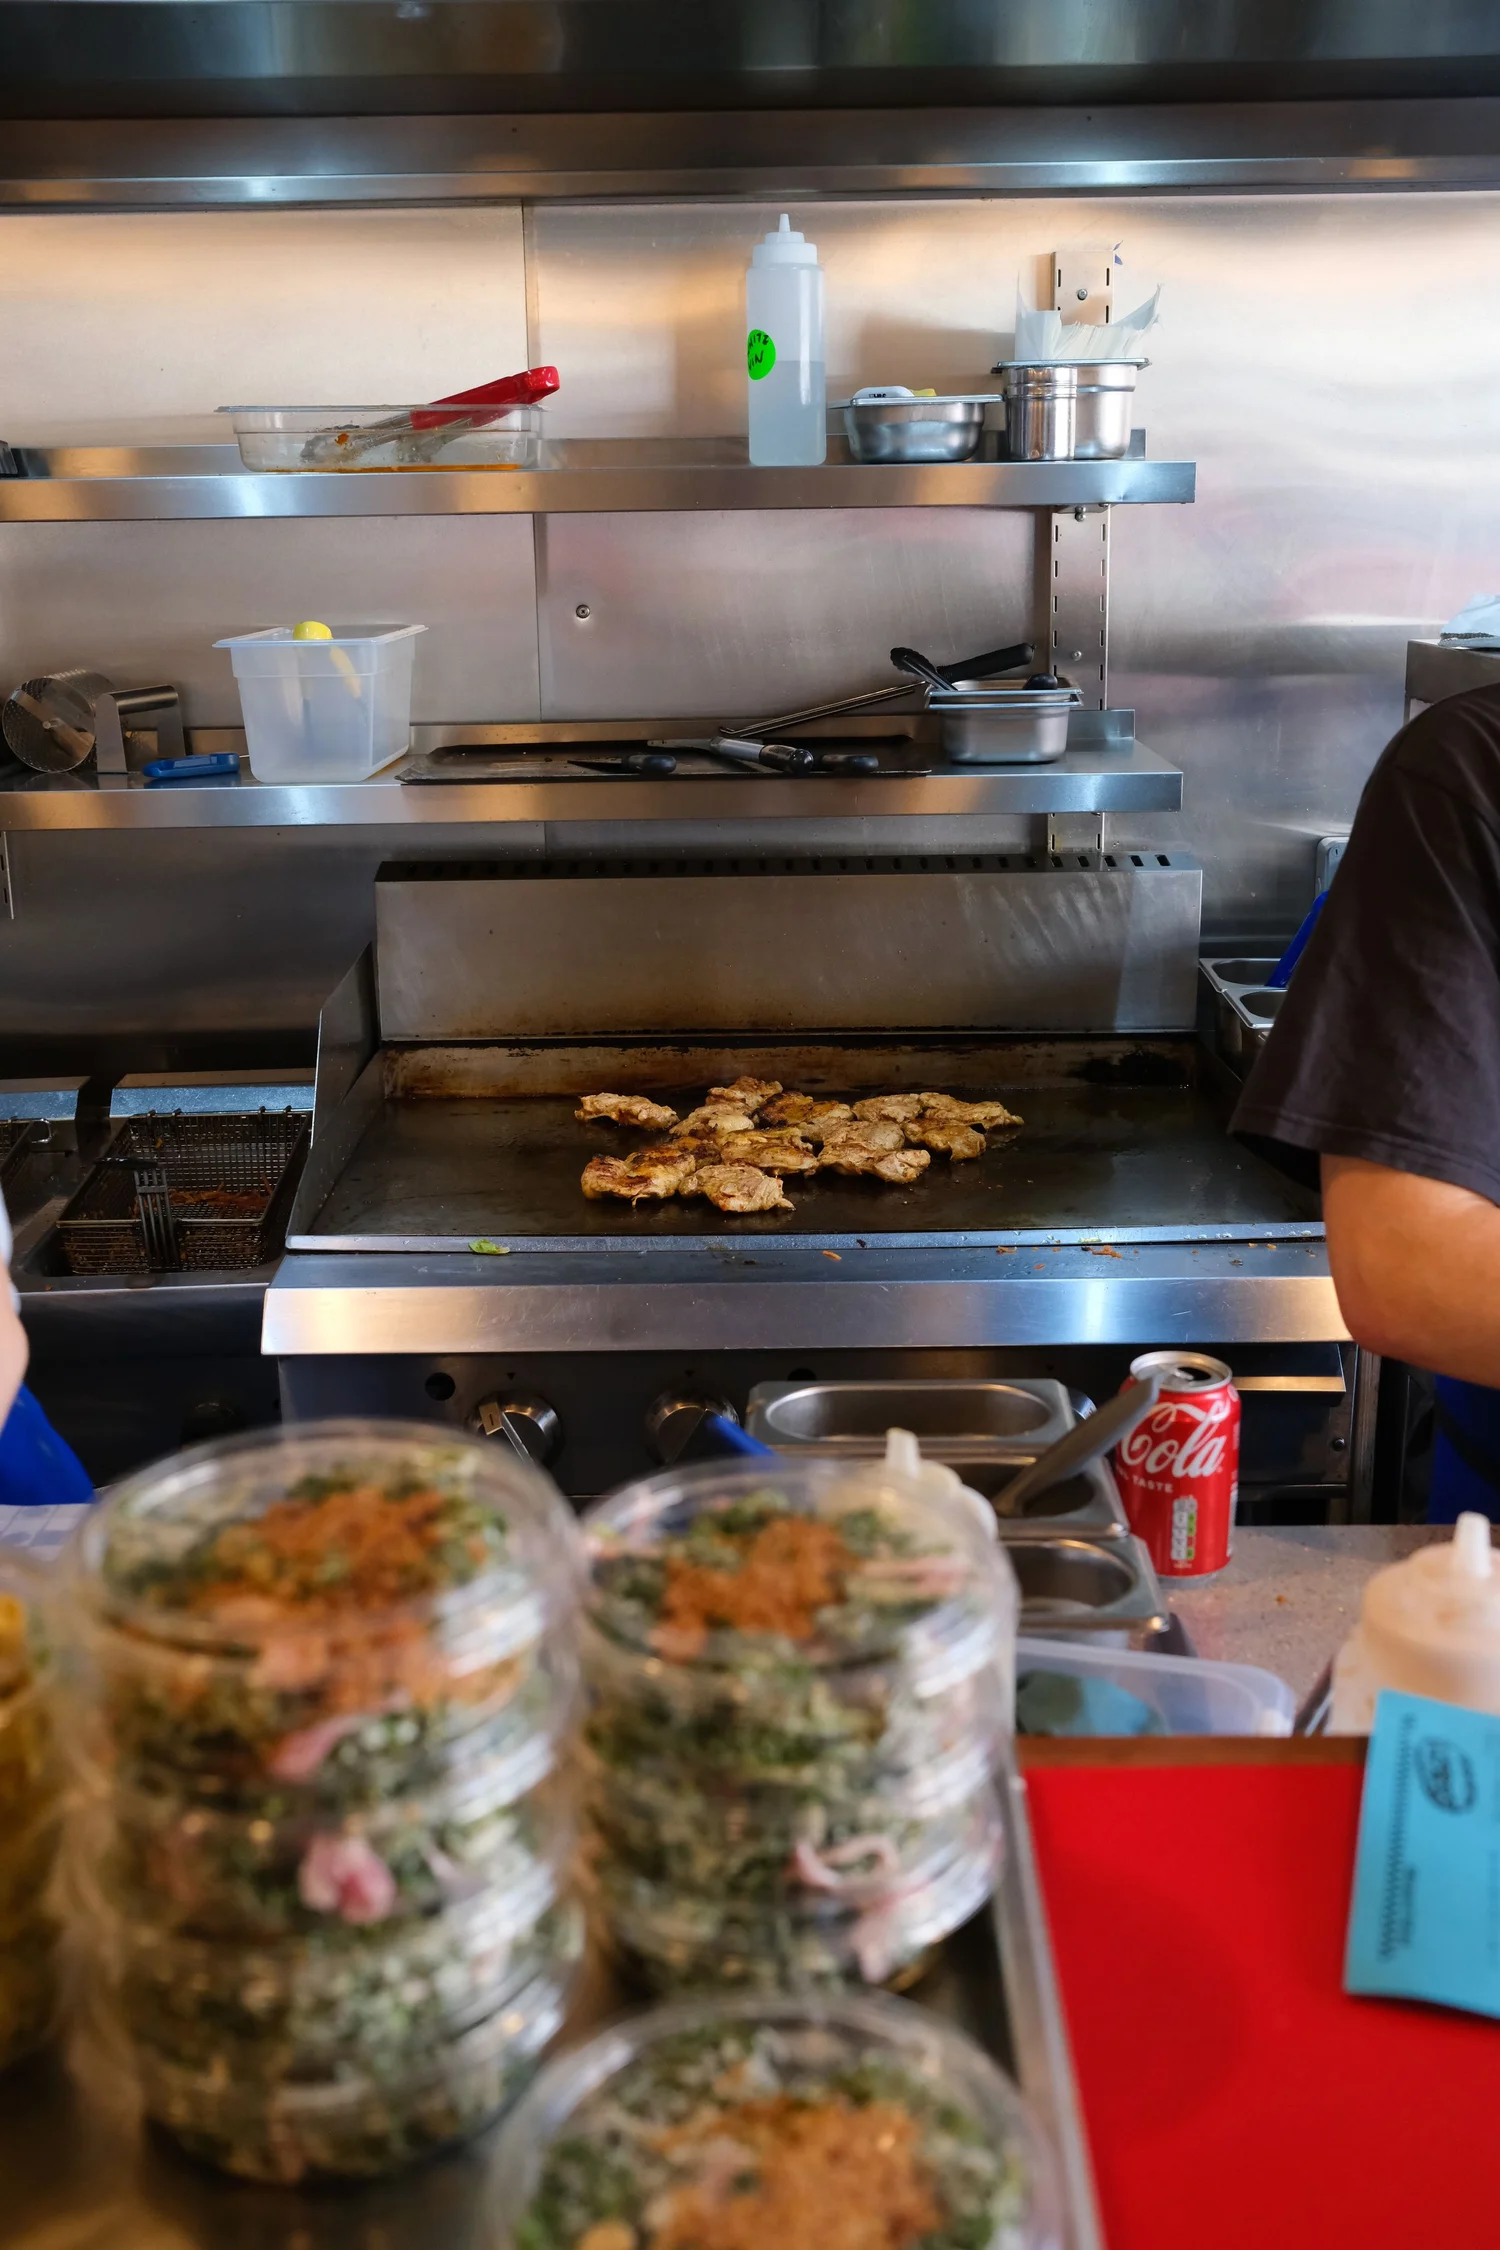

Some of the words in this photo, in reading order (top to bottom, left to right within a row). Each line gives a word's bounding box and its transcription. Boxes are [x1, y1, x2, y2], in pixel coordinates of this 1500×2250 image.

[748, 350, 764, 370] VIN
[1121, 1401, 1230, 1478] Cola
[1132, 1475, 1173, 1494] TASTE
